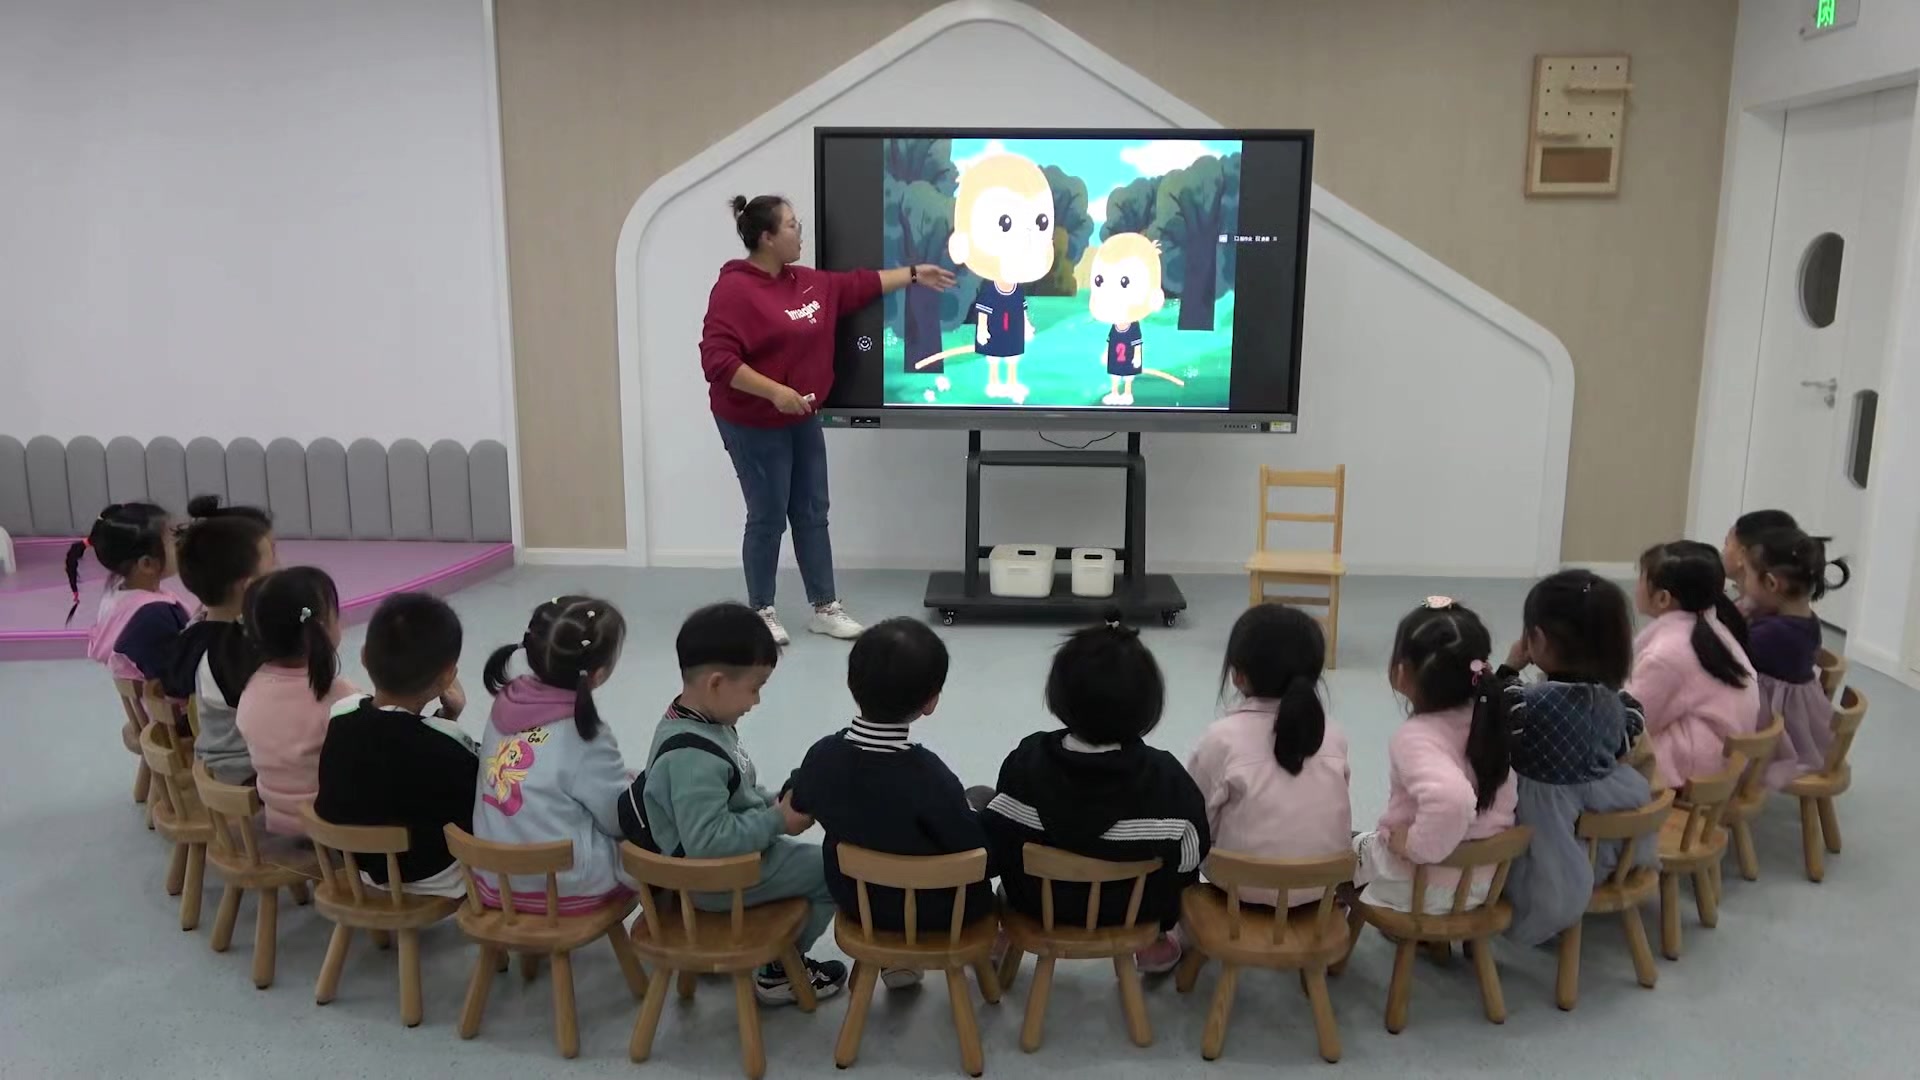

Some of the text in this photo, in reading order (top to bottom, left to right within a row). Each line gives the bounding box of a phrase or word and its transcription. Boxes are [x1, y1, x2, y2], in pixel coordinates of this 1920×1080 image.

[784, 300, 821, 321] Imagine
[1115, 342, 1127, 362] 2
[528, 732, 549, 743] Go!
